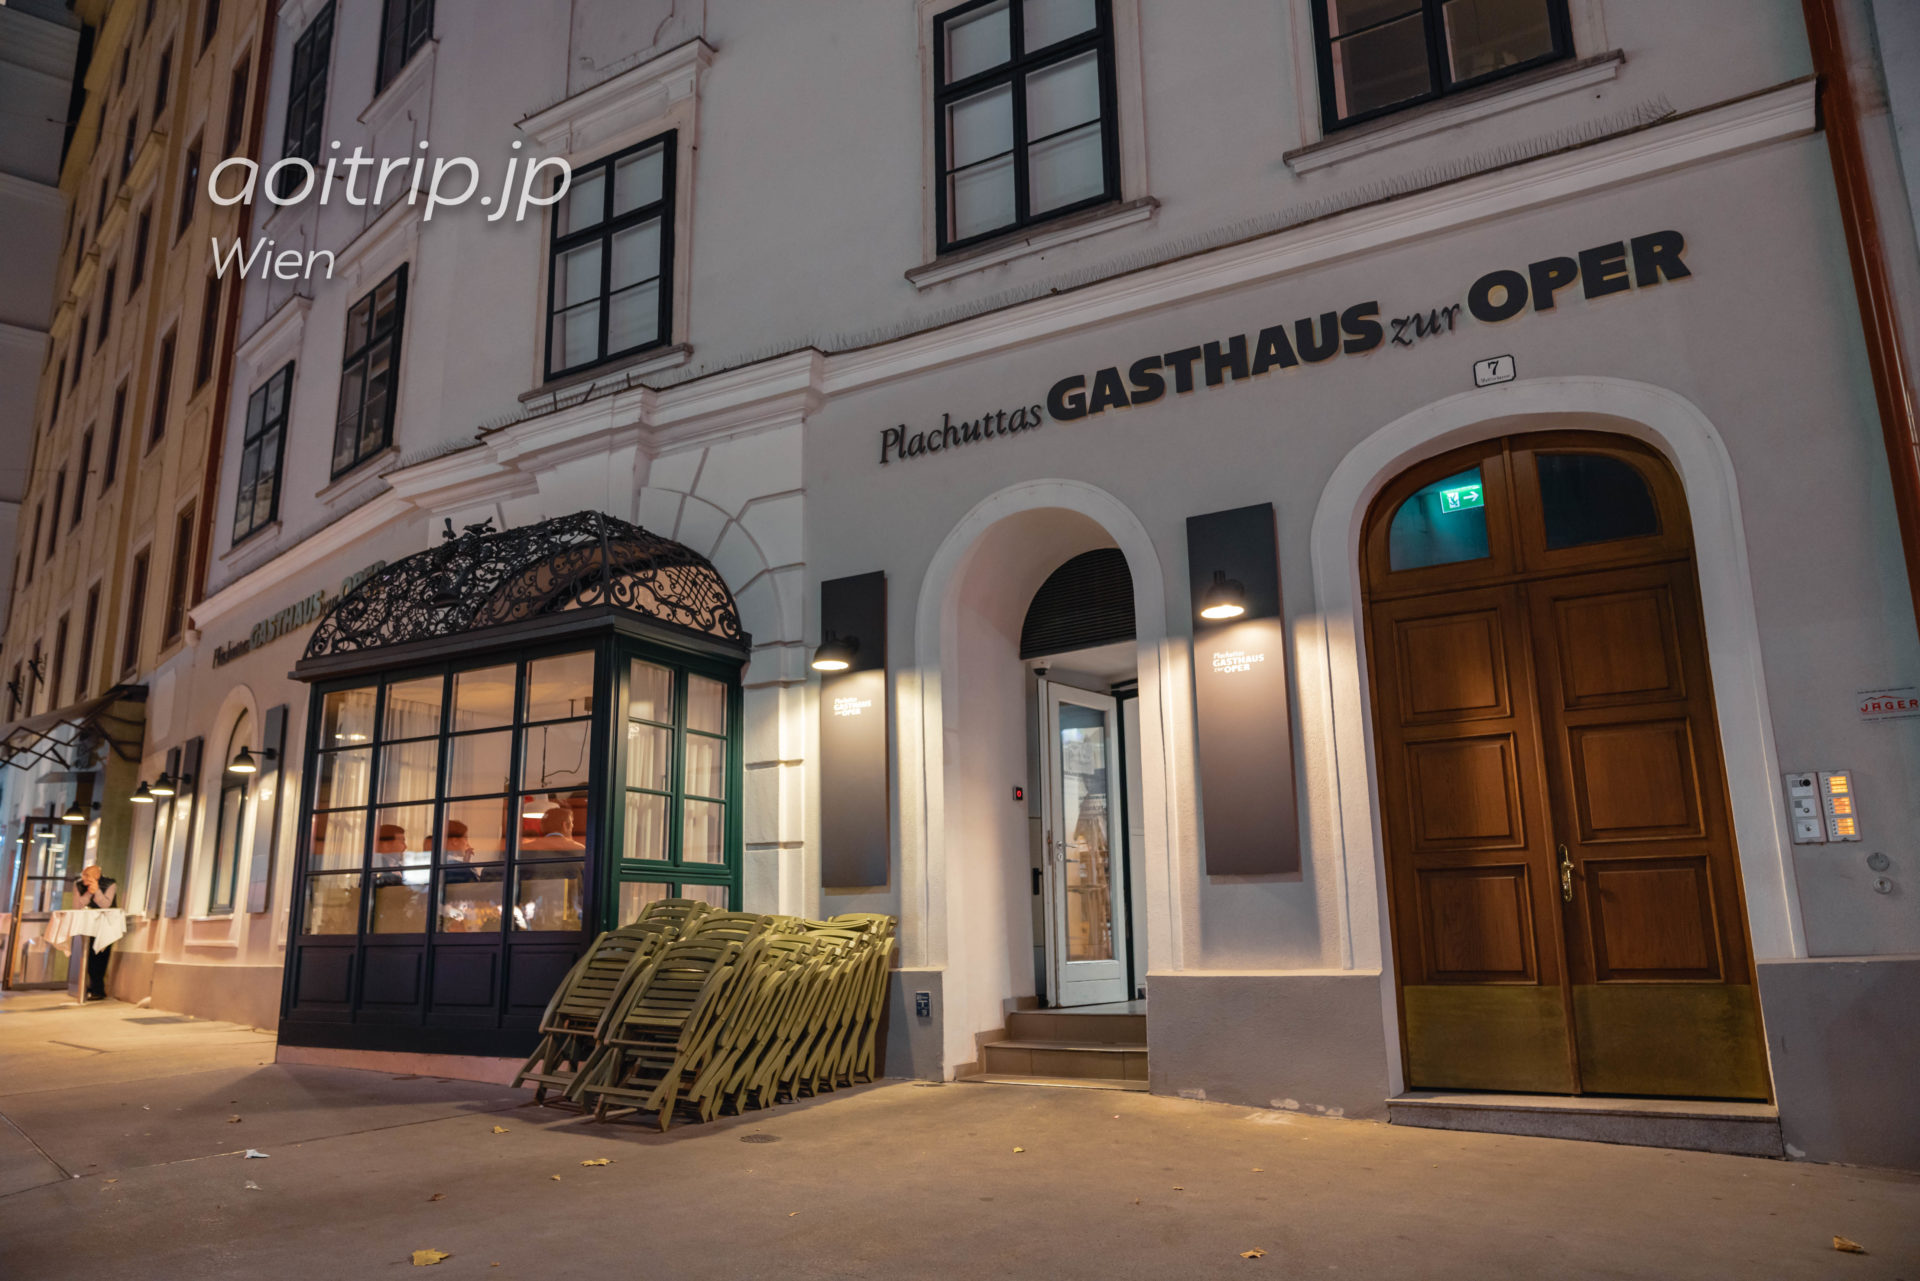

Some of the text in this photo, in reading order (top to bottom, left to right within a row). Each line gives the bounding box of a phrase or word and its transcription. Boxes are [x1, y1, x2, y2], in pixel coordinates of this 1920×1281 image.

[879, 229, 1692, 465] Plachuttas GASTHAUS zur OPER
[1487, 360, 1499, 376] 7
[250, 590, 324, 650] GASTHAUS
[1212, 653, 1265, 668] GASTHAUS
[1223, 663, 1251, 673] OPER
